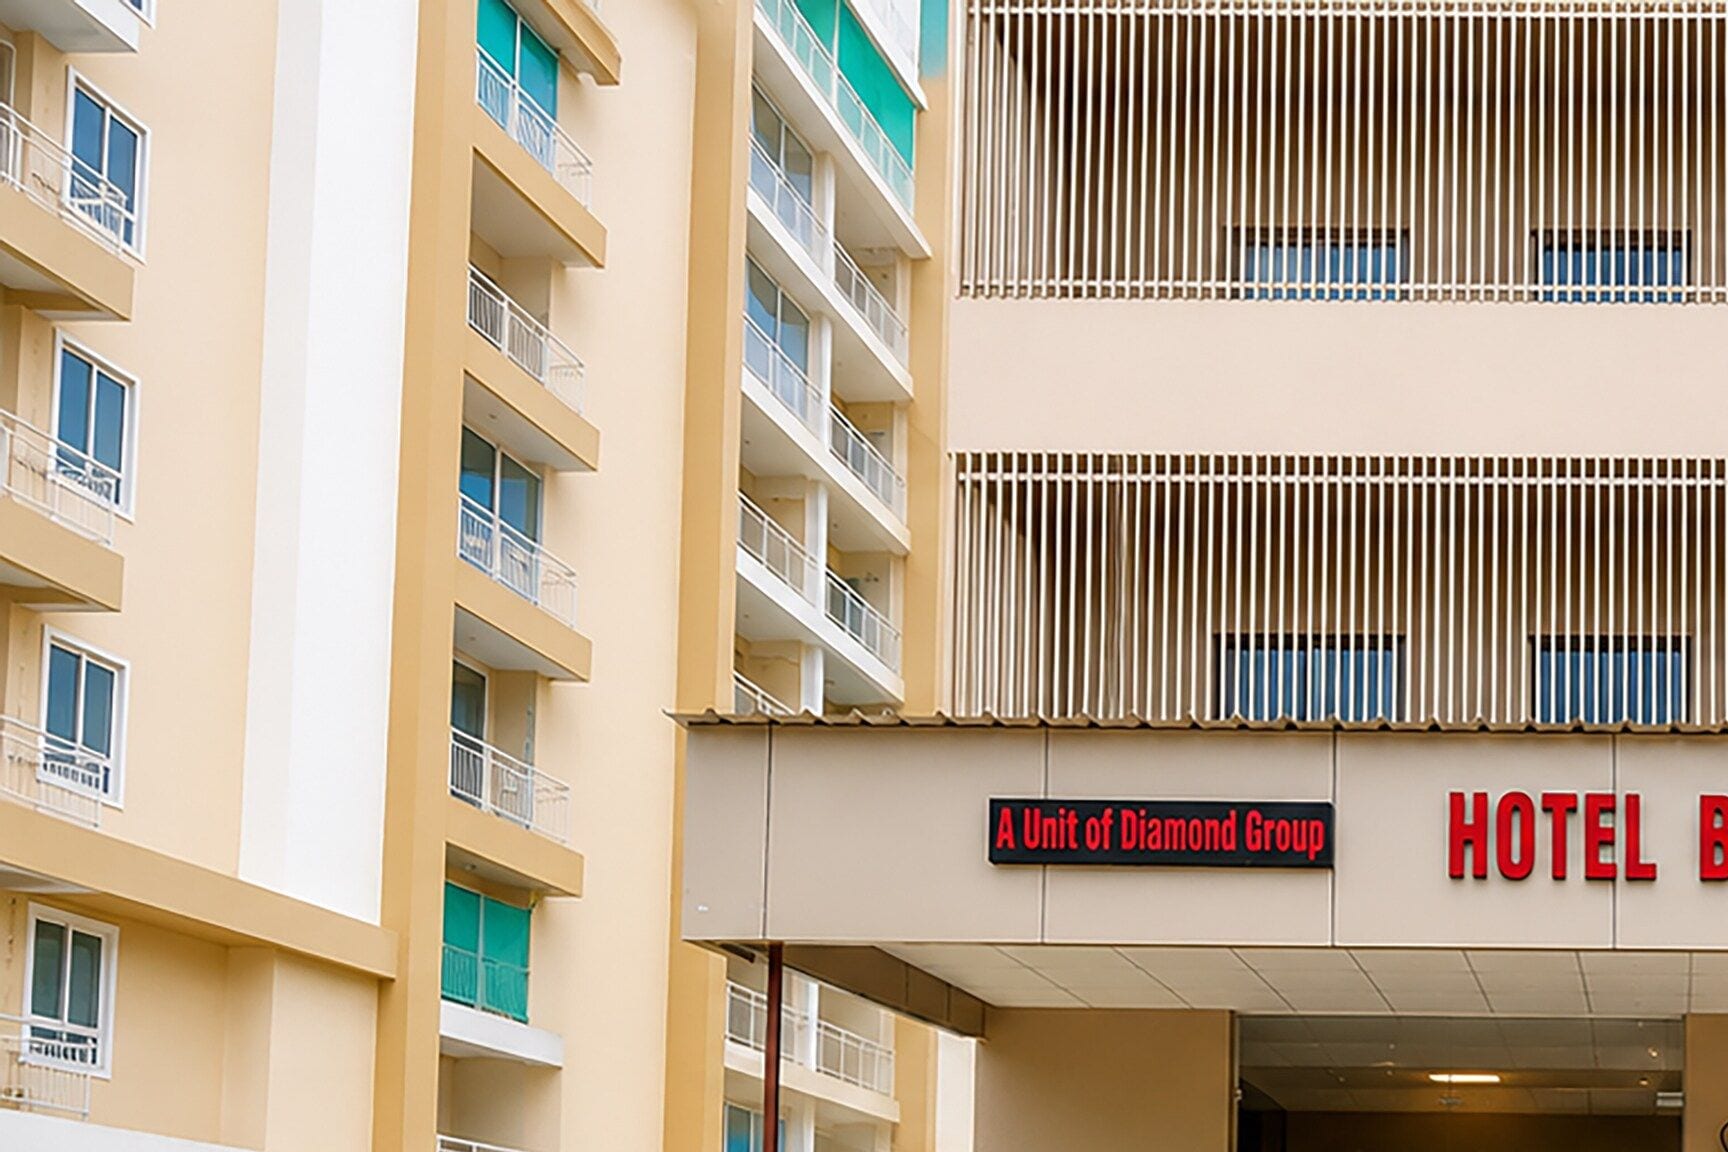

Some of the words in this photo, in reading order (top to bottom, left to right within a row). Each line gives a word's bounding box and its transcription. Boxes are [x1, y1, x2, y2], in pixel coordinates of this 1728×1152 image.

[995, 807, 1016, 849] A
[1022, 807, 1079, 850] Unit
[1085, 807, 1114, 851] of
[1120, 808, 1237, 852] Diamond
[1245, 809, 1325, 861] Group
[1448, 791, 1657, 880] HOTEL
